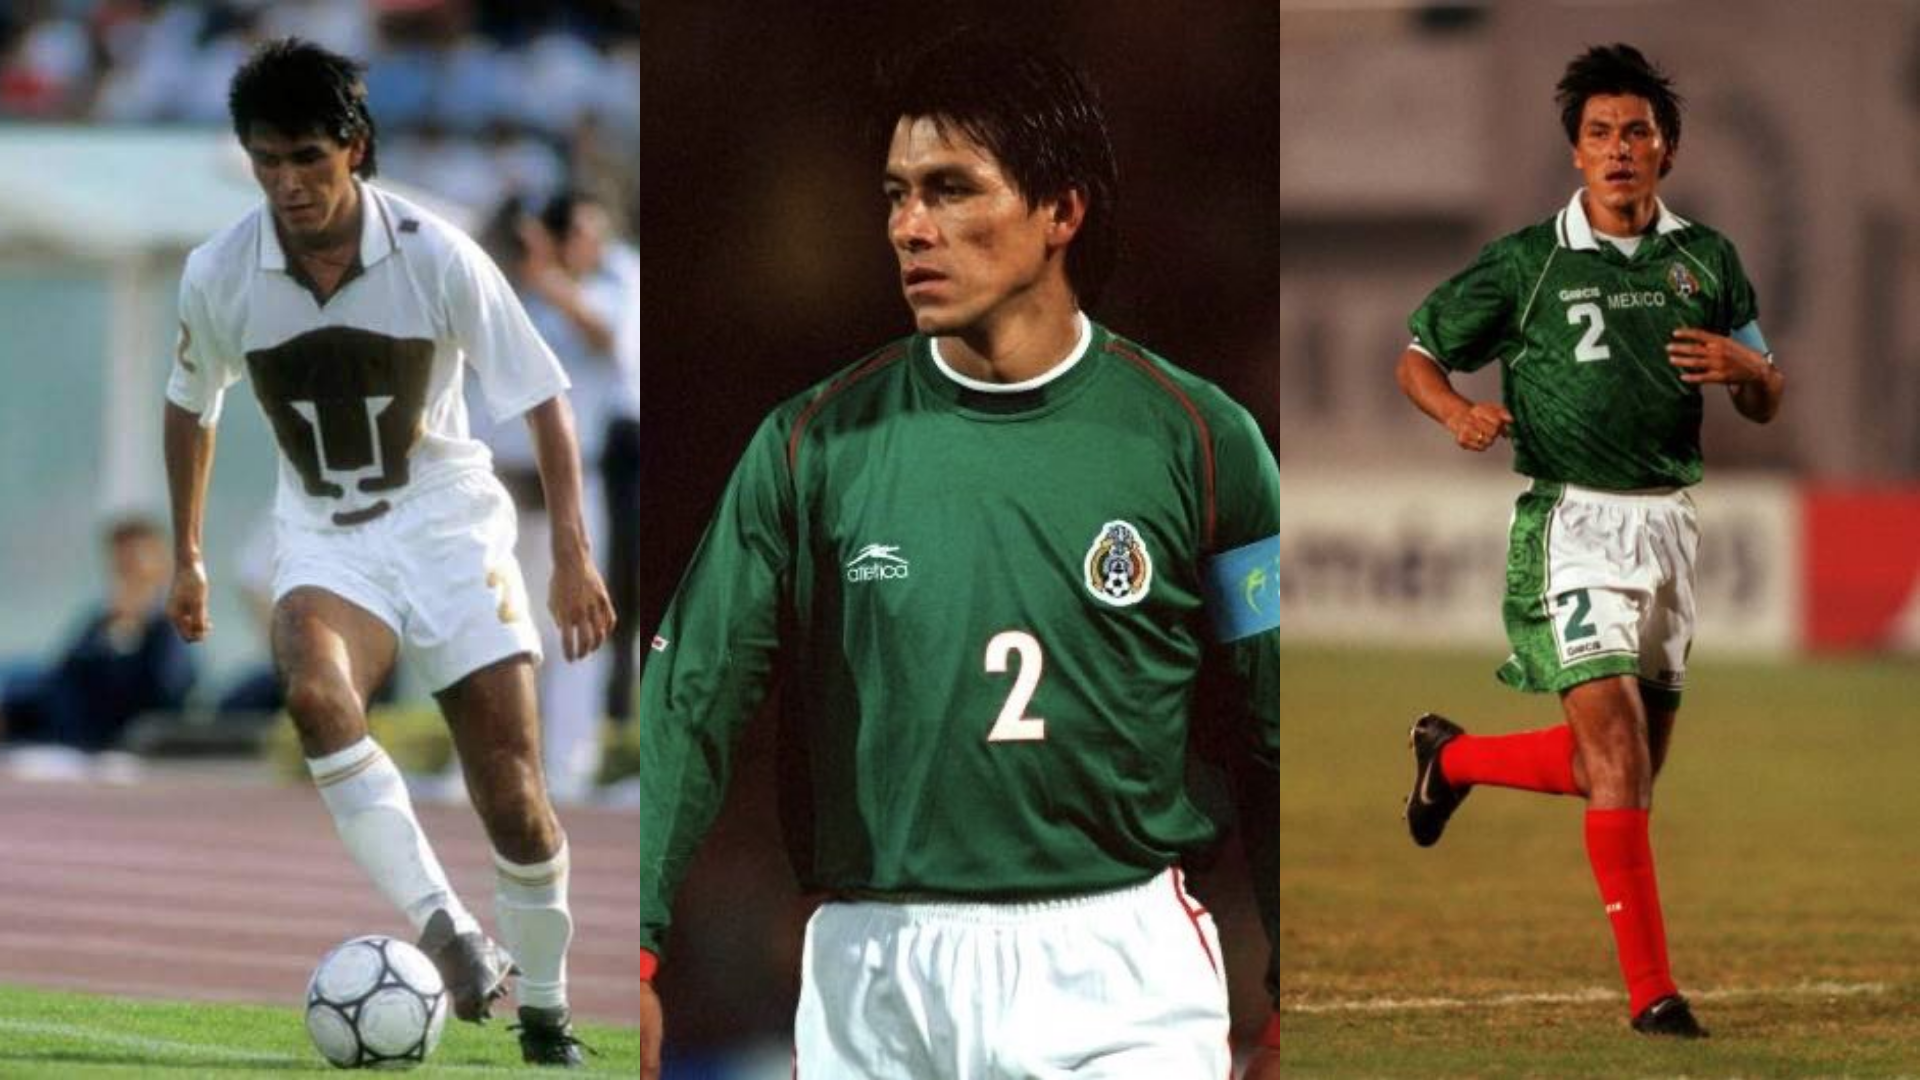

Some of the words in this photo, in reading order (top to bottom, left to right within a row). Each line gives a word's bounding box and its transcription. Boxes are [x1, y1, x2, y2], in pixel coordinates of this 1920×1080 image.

[1606, 291, 1666, 310] MEXICO
[1567, 302, 1610, 362] 2
[1556, 588, 1597, 642] 2
[984, 630, 1045, 742] 2
